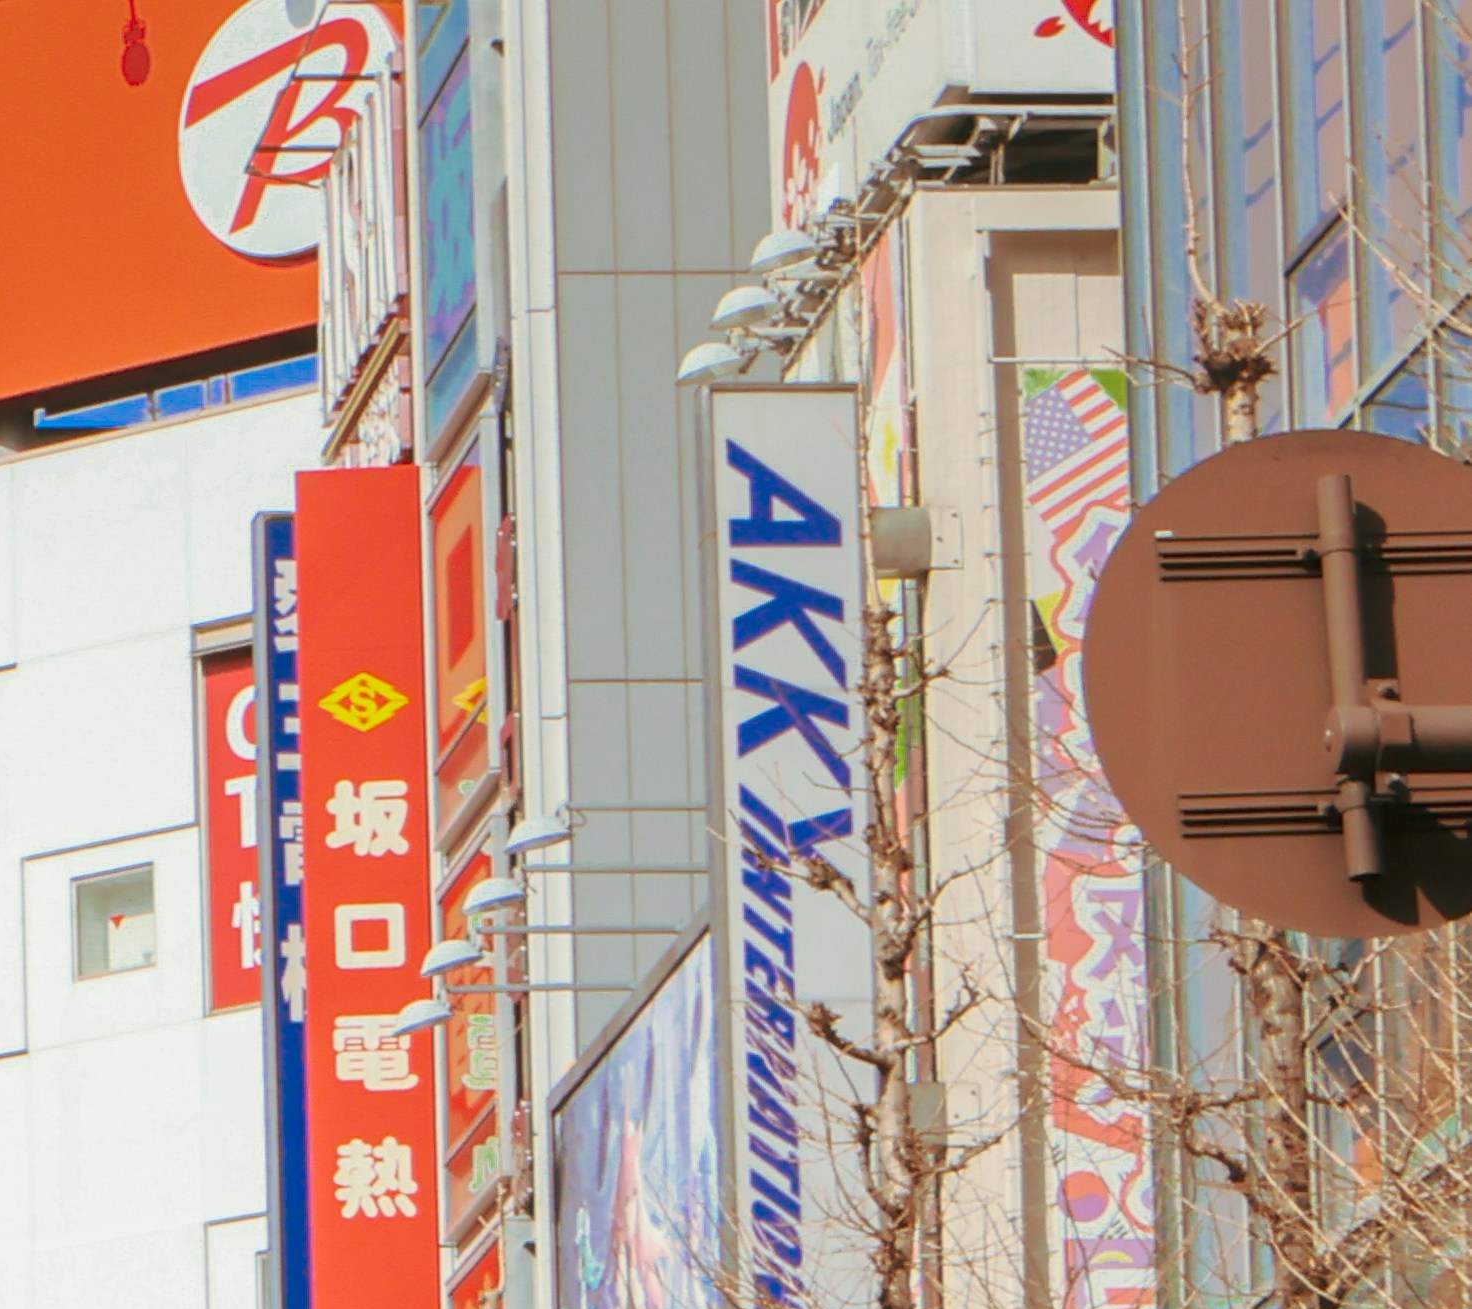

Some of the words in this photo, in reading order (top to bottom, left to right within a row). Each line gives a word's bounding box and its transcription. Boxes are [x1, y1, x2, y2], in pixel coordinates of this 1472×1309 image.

[725, 438, 855, 866] AKKY
[323, 779, 420, 1219] 坂口電熱
